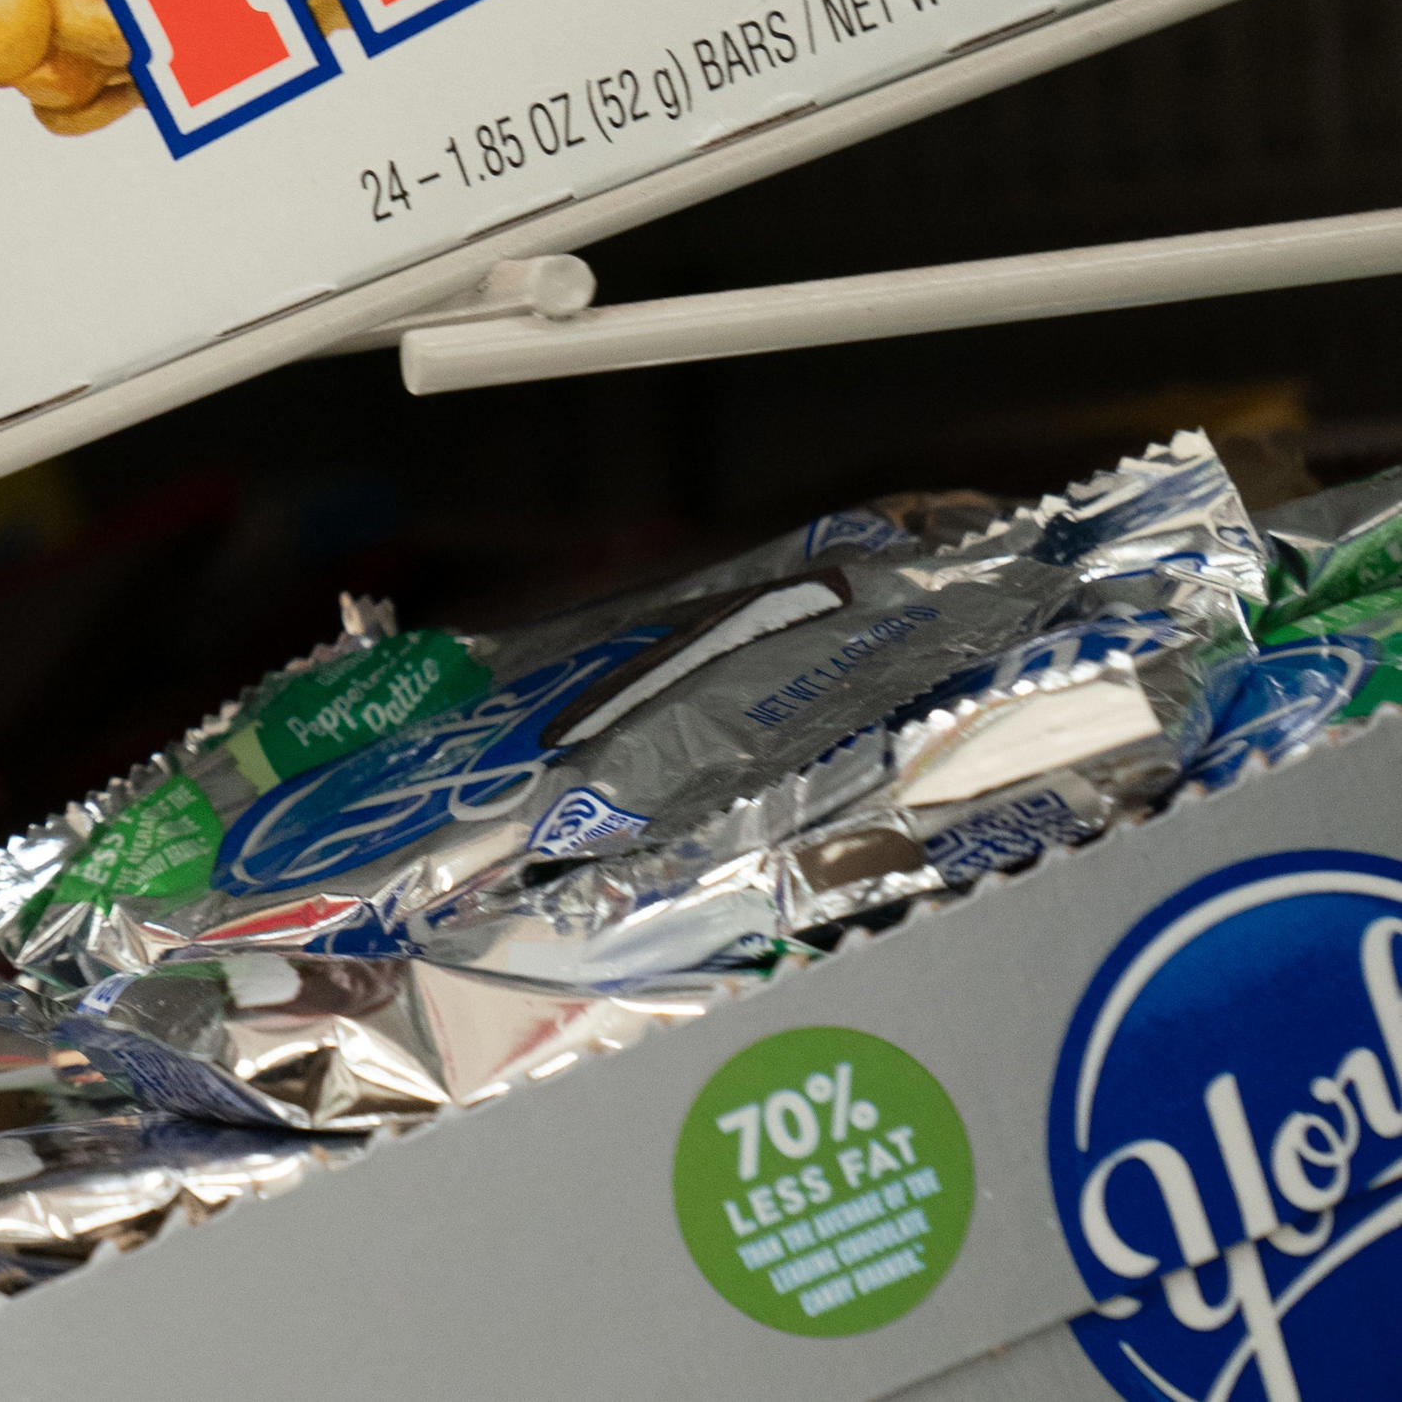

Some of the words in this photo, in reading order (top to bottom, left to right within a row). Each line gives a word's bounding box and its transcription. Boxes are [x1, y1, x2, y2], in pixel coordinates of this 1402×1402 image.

[529, 92, 587, 156] OZ
[585, 68, 650, 144] (52
[652, 47, 694, 121] g)
[692, 9, 798, 92] BARS
[715, 1061, 881, 1183] 70%
[722, 1163, 834, 1238] LESS
[836, 1125, 918, 1189] FAT
